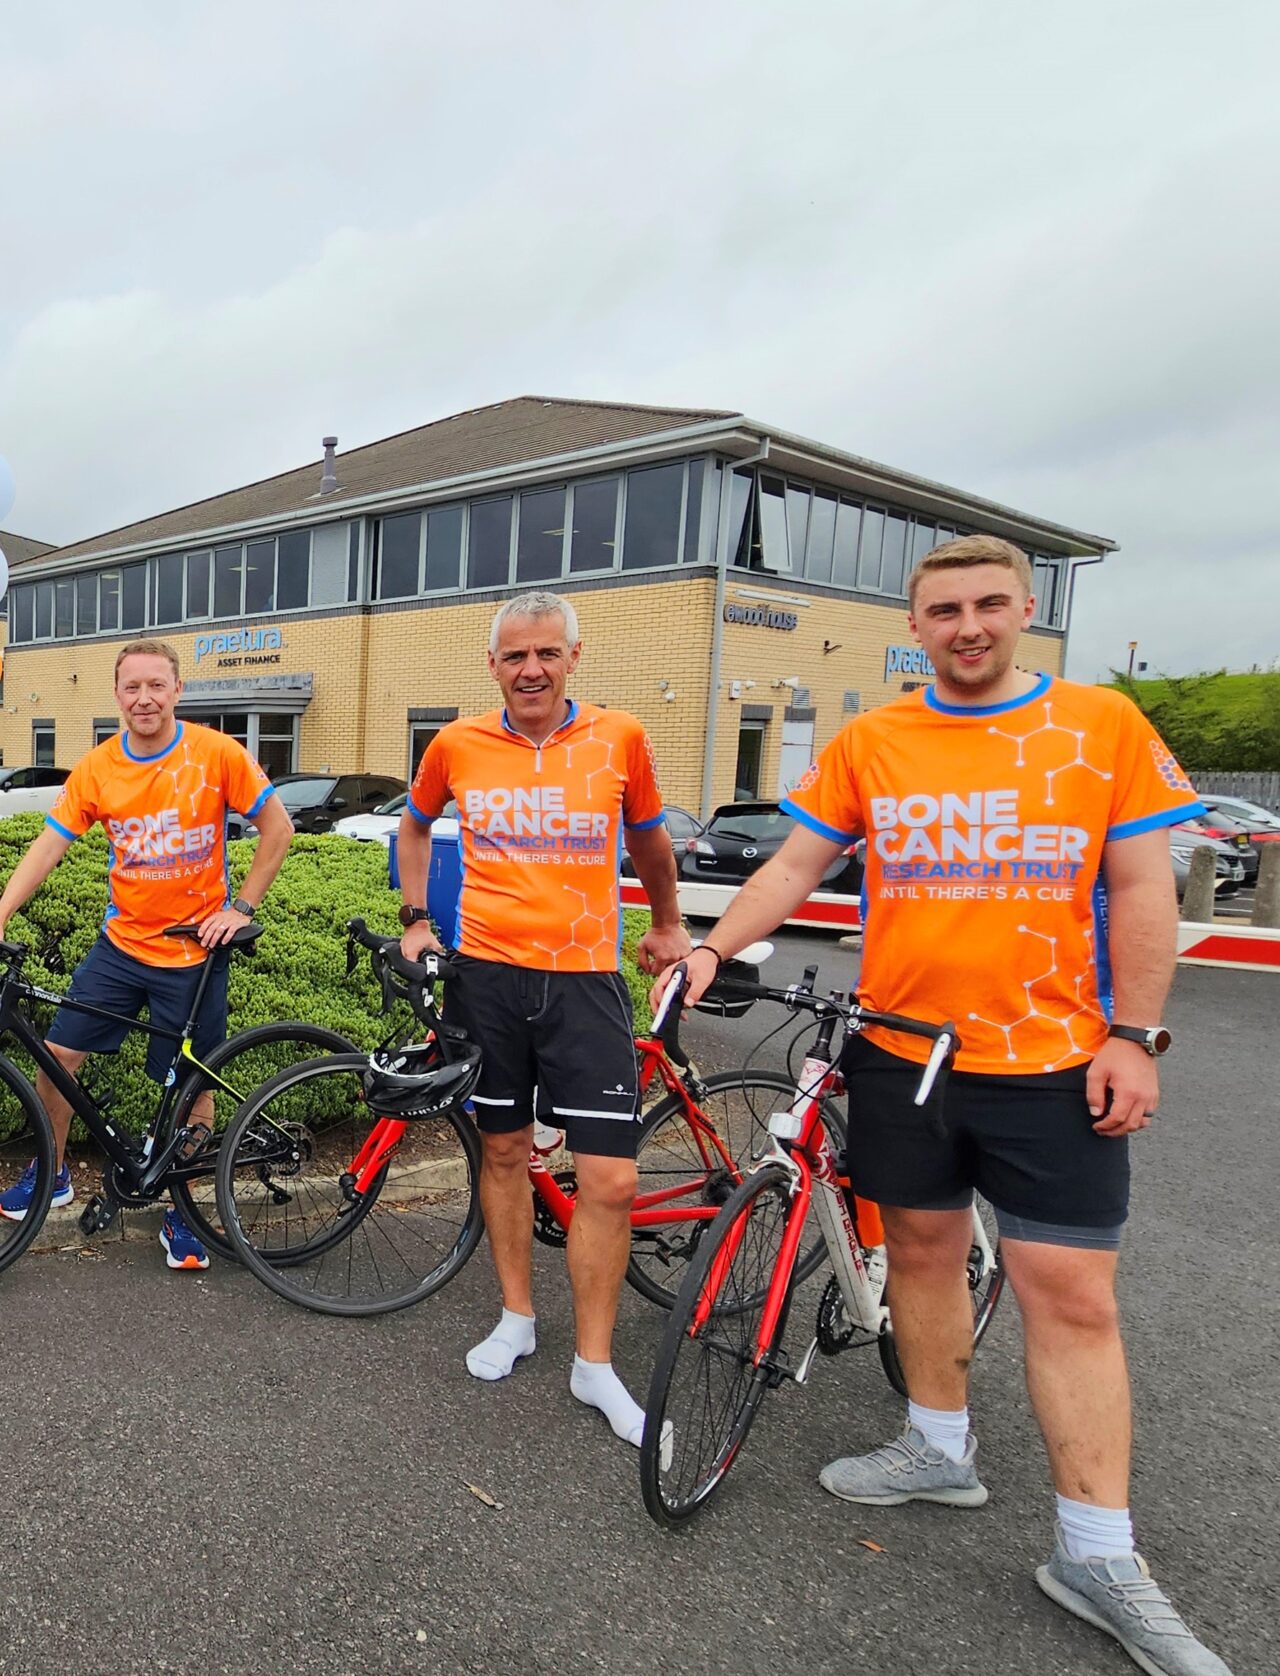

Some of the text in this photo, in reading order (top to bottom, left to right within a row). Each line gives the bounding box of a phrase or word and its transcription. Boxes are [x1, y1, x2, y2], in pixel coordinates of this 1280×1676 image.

[195, 627, 283, 664] praetura
[217, 654, 281, 668] ASSET FINANCE
[465, 786, 565, 813] BONE
[871, 789, 1019, 830] BONE
[108, 808, 181, 839] BONE
[467, 811, 609, 837] CANCER
[561, 836, 607, 849] TRUST
[874, 825, 1089, 862] CANCER
[507, 853, 561, 864] THERE'S
[565, 855, 575, 864] A
[578, 856, 606, 865] CURE
[925, 885, 1008, 900] THERE'S
[1013, 886, 1030, 900] A
